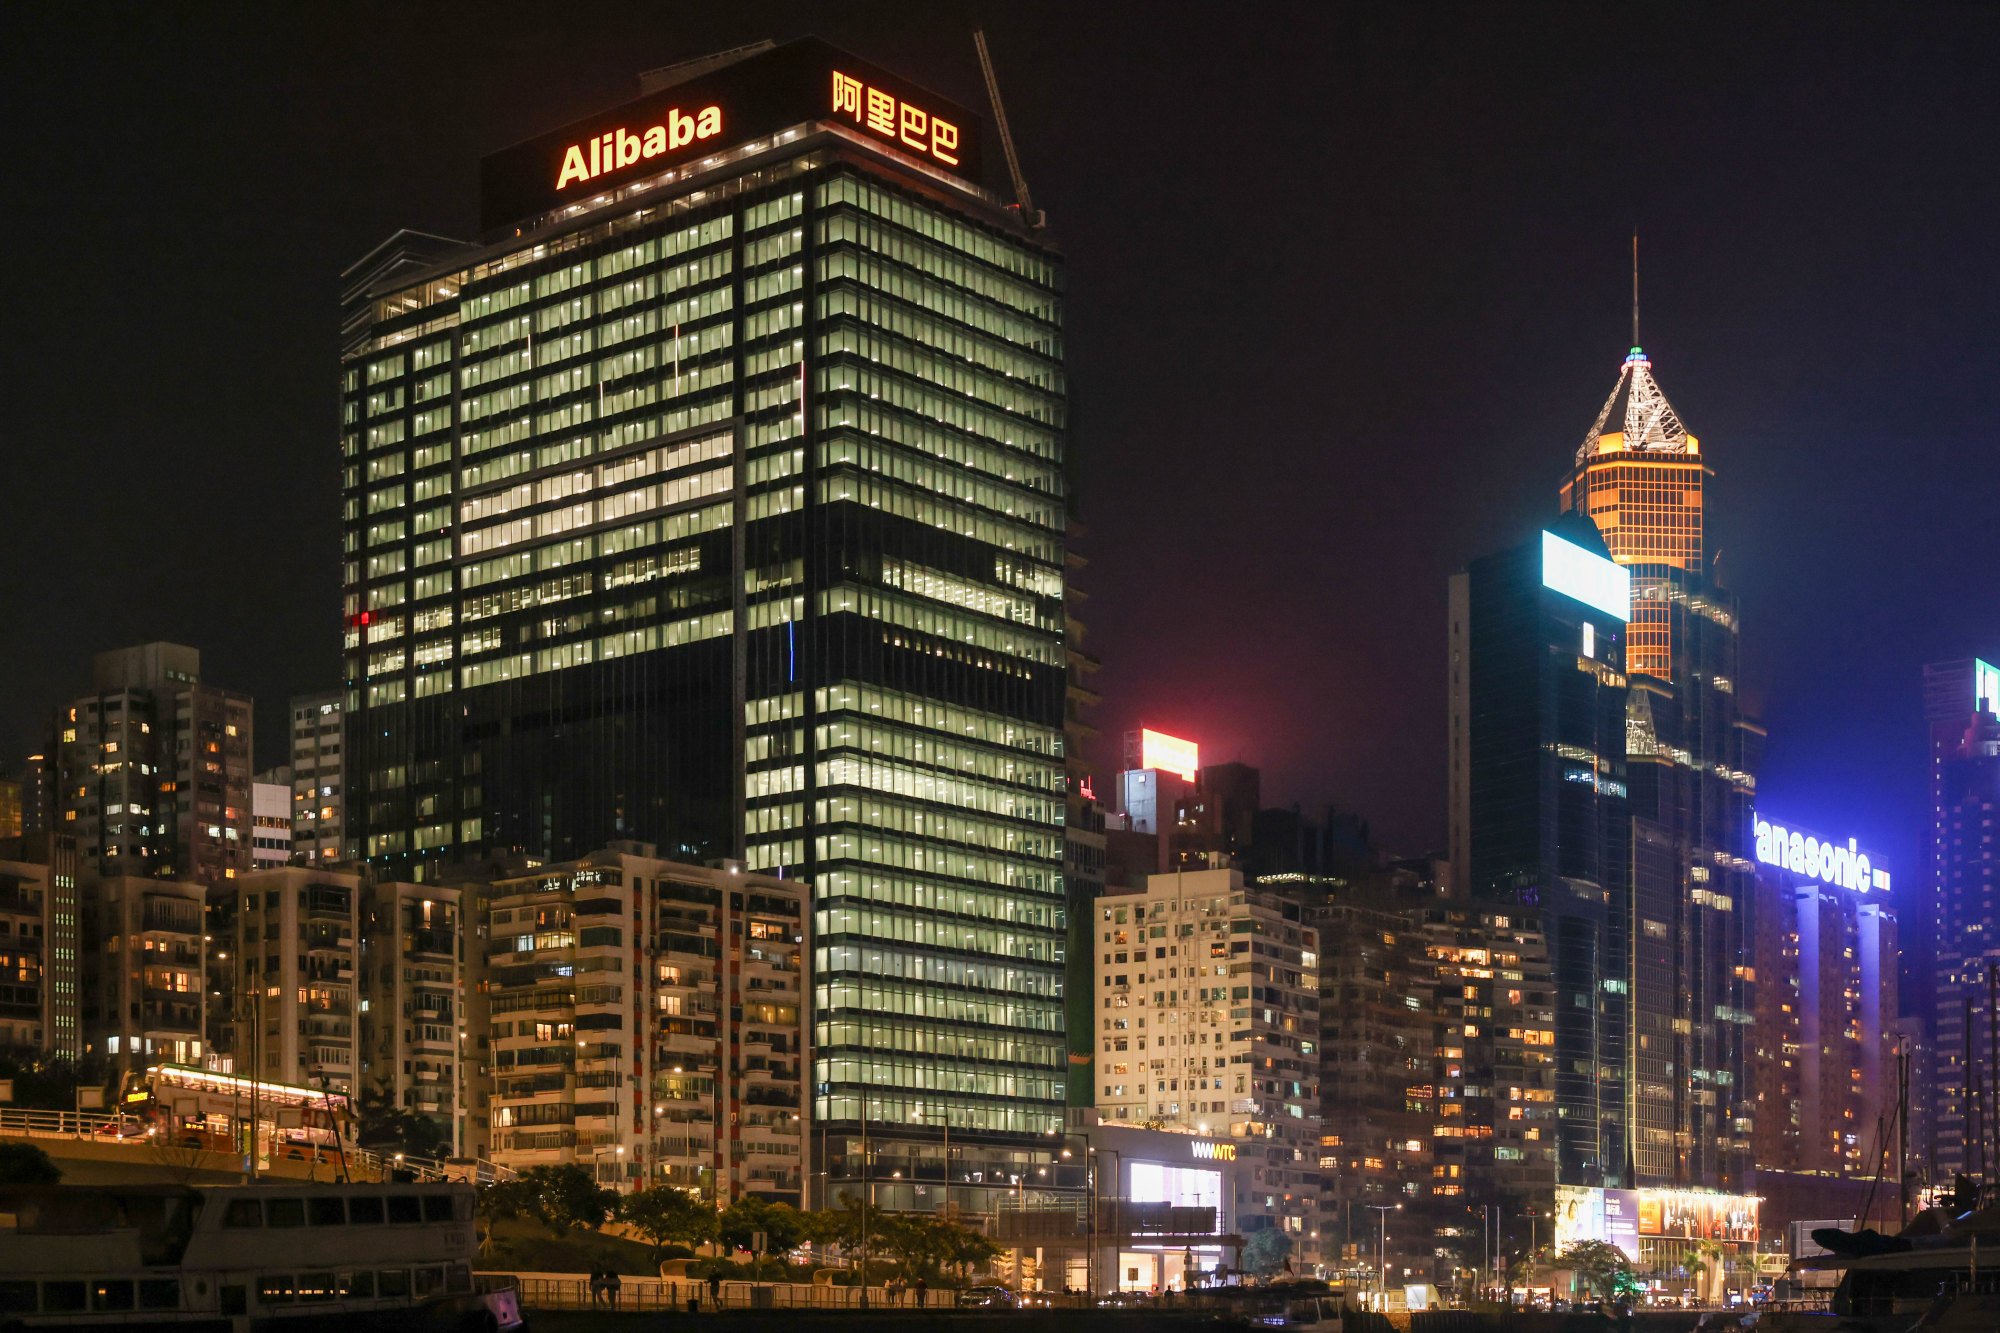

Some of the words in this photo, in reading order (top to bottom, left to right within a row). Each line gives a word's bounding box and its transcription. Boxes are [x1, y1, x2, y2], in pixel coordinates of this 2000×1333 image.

[556, 105, 722, 191] Alibaba
[832, 70, 959, 167] 阿里巴巴
